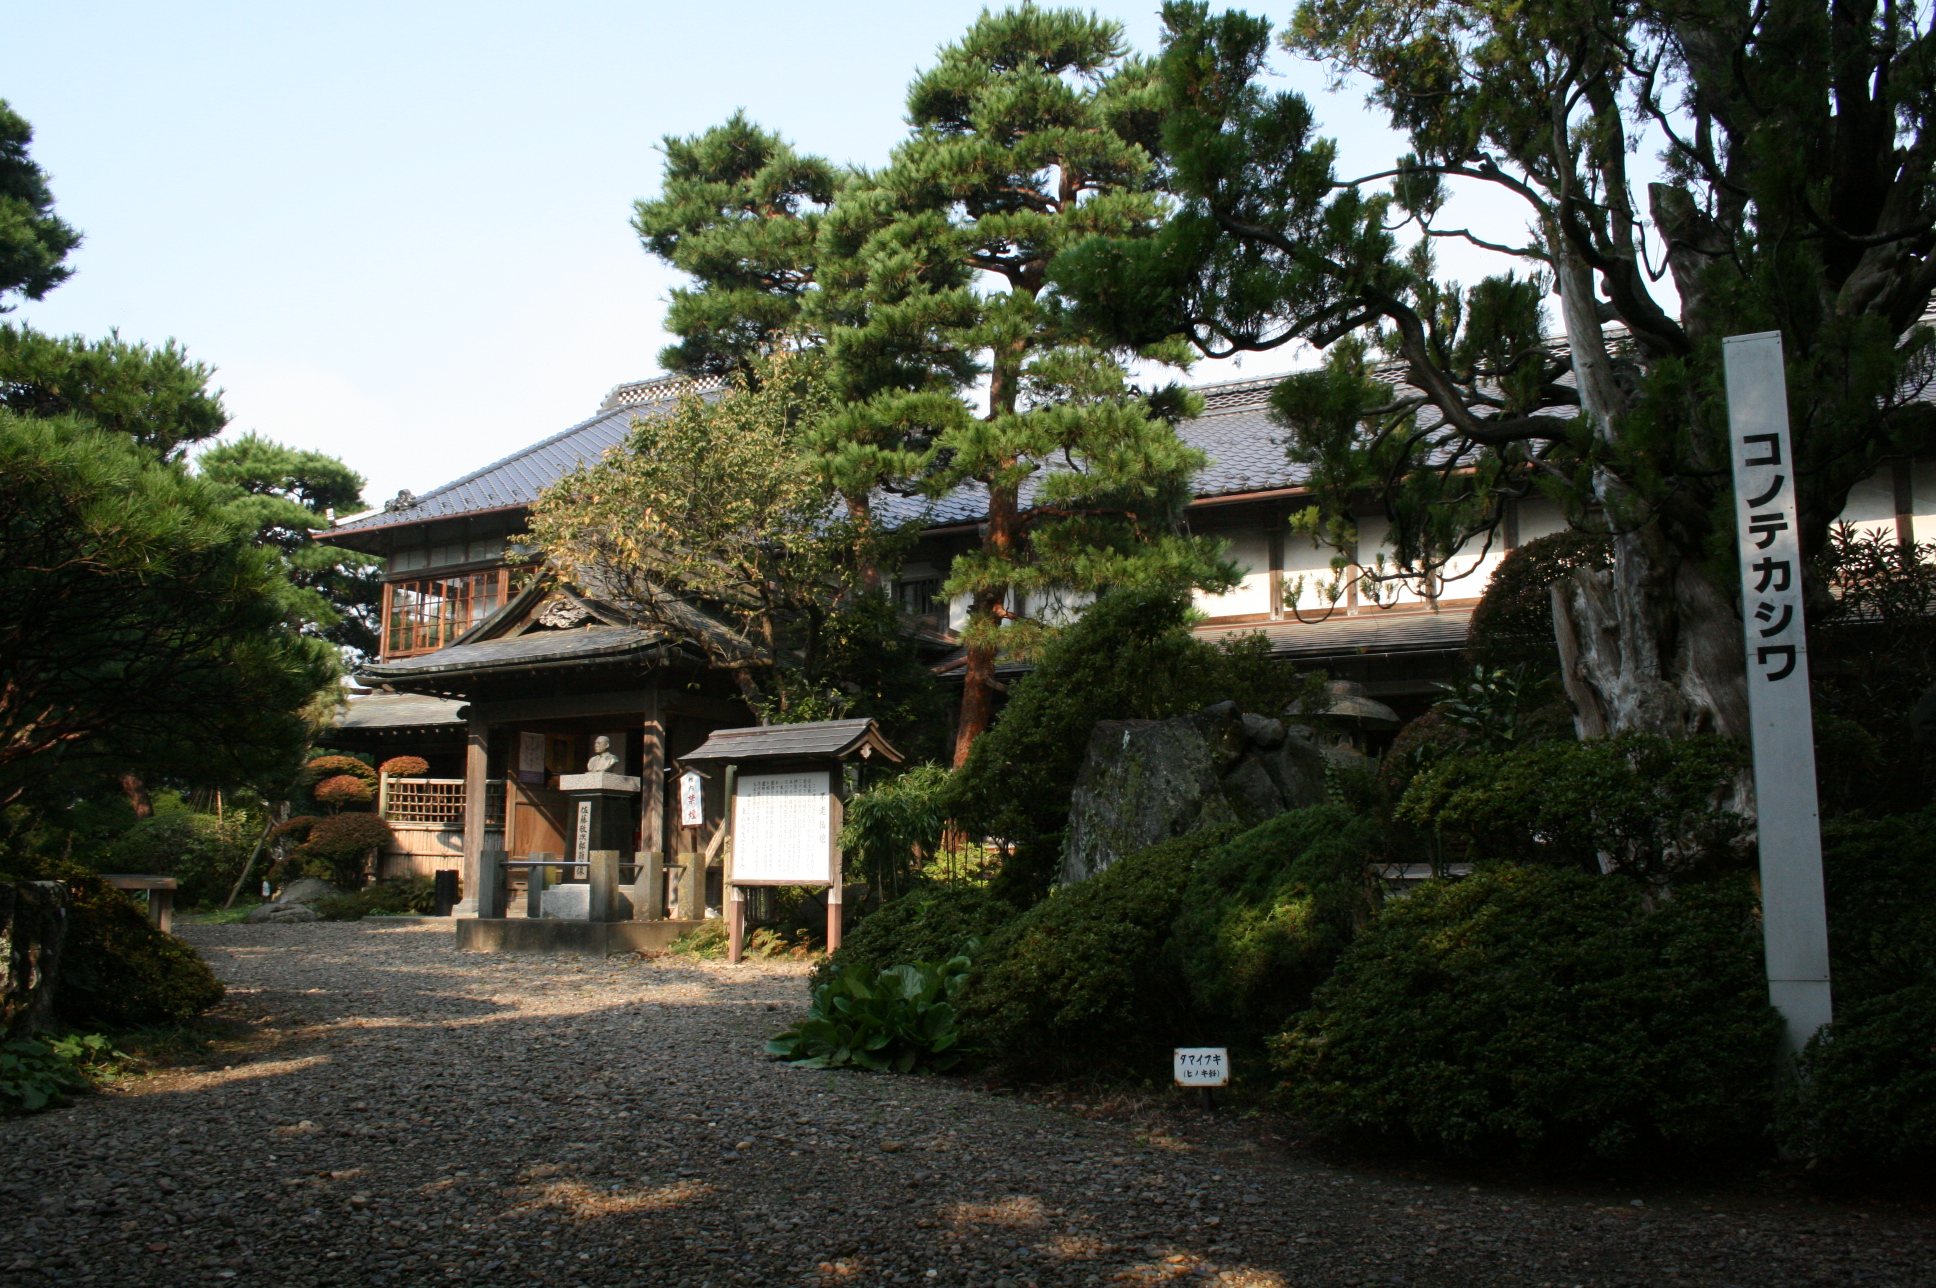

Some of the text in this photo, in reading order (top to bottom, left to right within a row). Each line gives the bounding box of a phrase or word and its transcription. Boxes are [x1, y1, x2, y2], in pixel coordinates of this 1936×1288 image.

[1743, 432, 1796, 682] コノテカシワ
